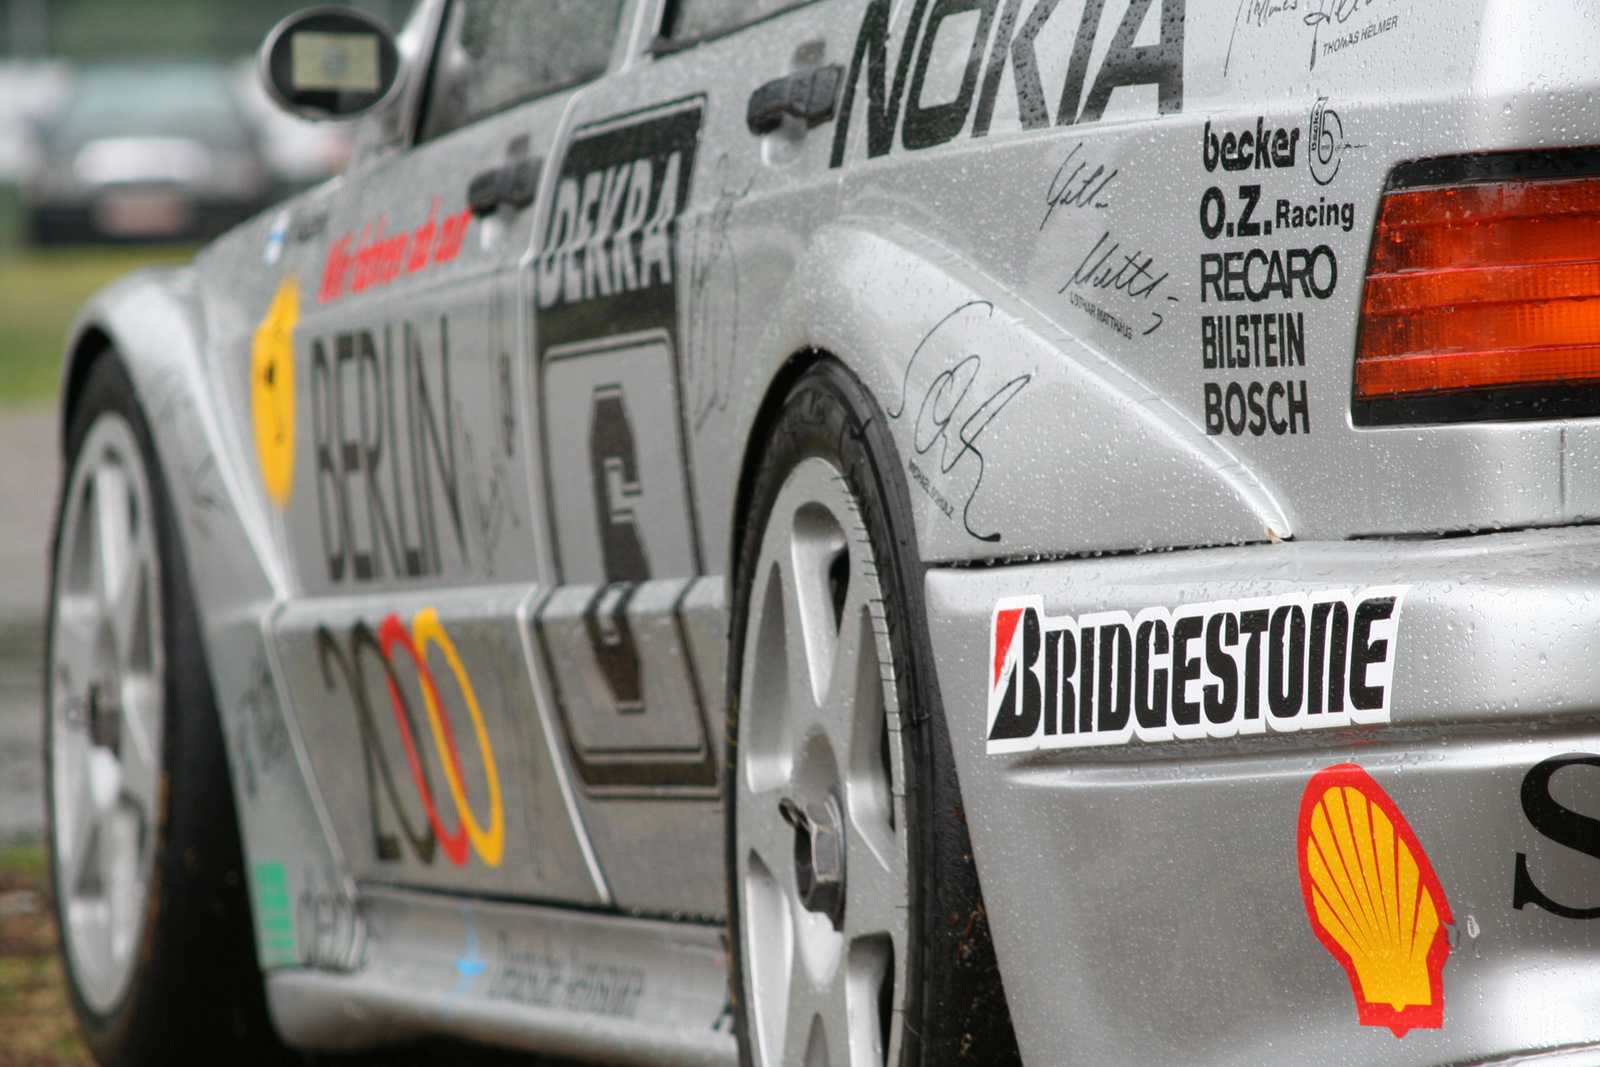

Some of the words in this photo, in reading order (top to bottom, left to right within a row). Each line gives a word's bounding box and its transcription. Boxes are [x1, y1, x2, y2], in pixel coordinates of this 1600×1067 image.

[1323, 33, 1359, 56] THOMAS
[1360, 15, 1398, 40] HELMER
[829, 0, 1185, 168] NOKIA
[1203, 116, 1300, 172] becker
[538, 150, 681, 308] DEKRA
[1276, 197, 1354, 232] Racing
[1201, 245, 1338, 302] RECARO
[1069, 291, 1096, 318] LOTHAR
[1202, 312, 1305, 369] BILSTEIN
[1204, 380, 1310, 436] BOSCH
[310, 314, 471, 582] BERLIN
[988, 597, 1398, 741] BRIDGESTONE
[316, 606, 505, 867] 2000
